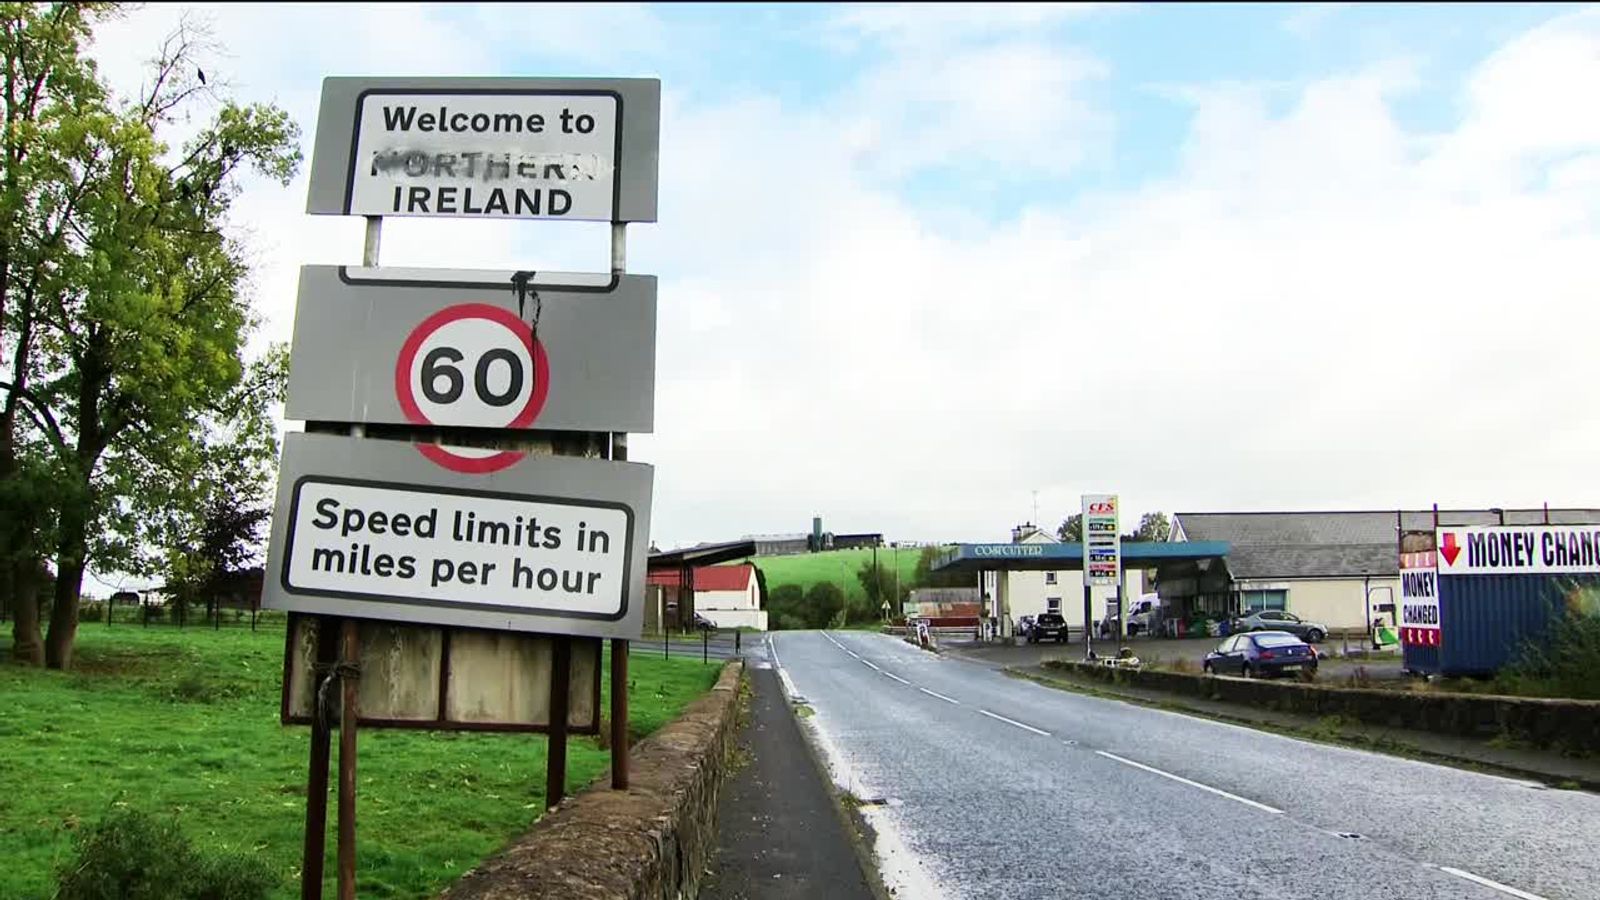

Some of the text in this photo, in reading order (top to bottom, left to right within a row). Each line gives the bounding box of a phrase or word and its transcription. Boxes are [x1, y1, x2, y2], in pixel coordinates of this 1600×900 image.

[383, 106, 595, 134] Welcome to
[393, 186, 573, 216] IRELAND
[420, 346, 524, 407] 60
[312, 497, 609, 553] Speed limits in
[1467, 531, 1534, 567] MONEY
[312, 543, 602, 594] miles per hour
[1402, 571, 1435, 597] MONEY
[1404, 604, 1438, 624] CHANGED
